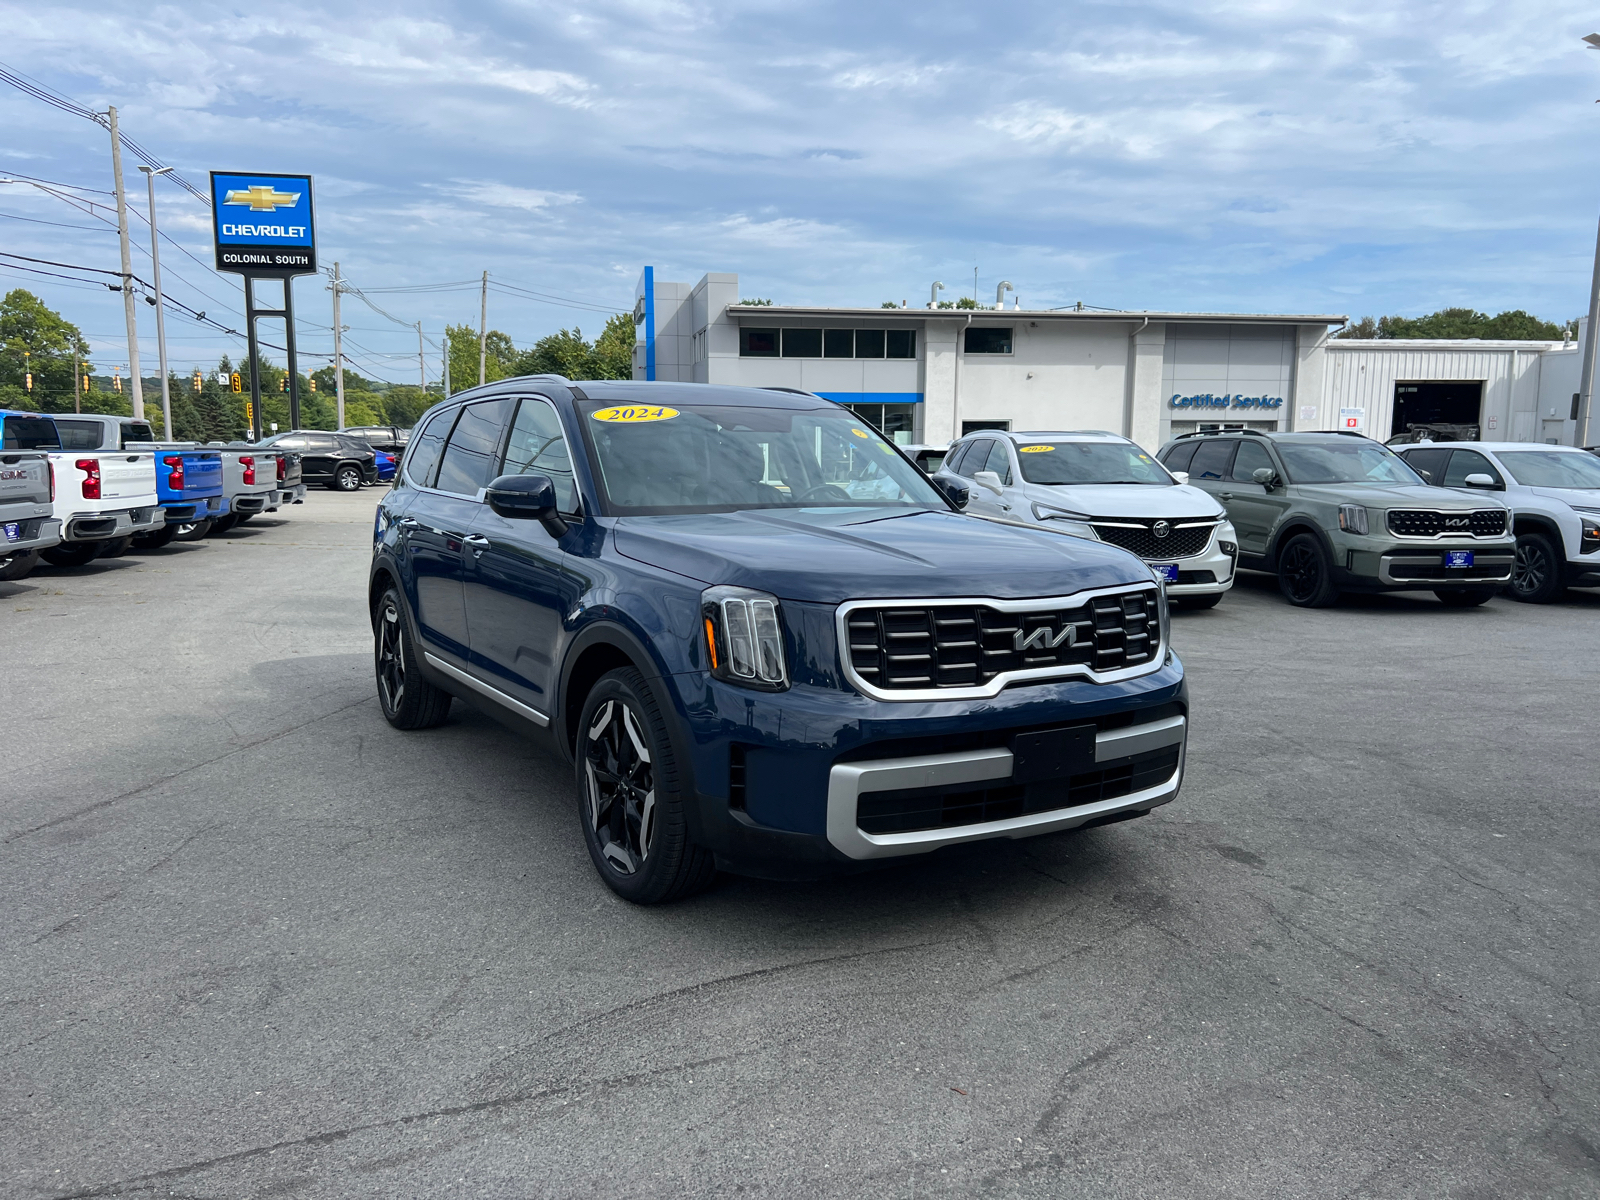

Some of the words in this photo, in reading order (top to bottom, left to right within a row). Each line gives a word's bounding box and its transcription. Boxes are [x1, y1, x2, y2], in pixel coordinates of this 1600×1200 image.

[222, 224, 306, 238] CHEVROLET
[223, 254, 273, 264] COLONIAL
[275, 255, 309, 265] SOUTH
[1172, 394, 1230, 407] Certified
[1235, 394, 1283, 407] Service
[607, 407, 665, 420] 2024
[1, 470, 28, 481] GMC
[1445, 518, 1470, 527] KIA
[1013, 624, 1077, 651] KIA
